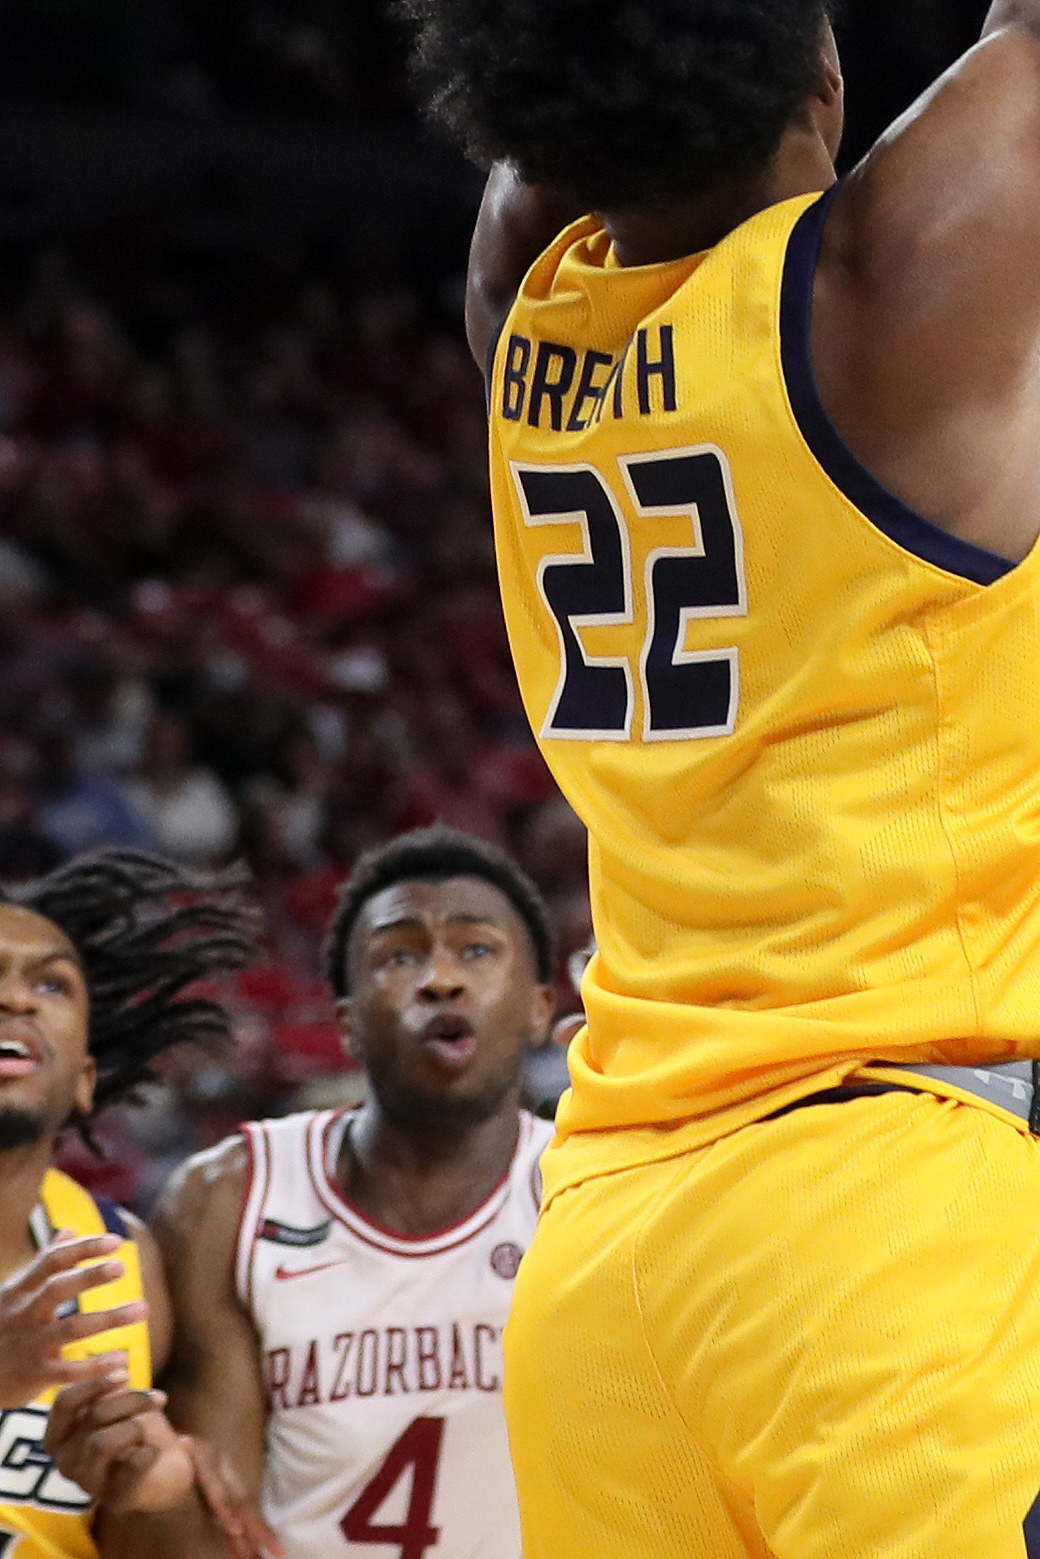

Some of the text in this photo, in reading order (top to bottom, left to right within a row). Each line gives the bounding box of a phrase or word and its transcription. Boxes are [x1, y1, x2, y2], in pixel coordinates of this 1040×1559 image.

[502, 324, 677, 432] BREH
[508, 441, 748, 742] 22
[266, 1322, 504, 1410] RAZORBAC
[338, 1416, 445, 1559] 4
